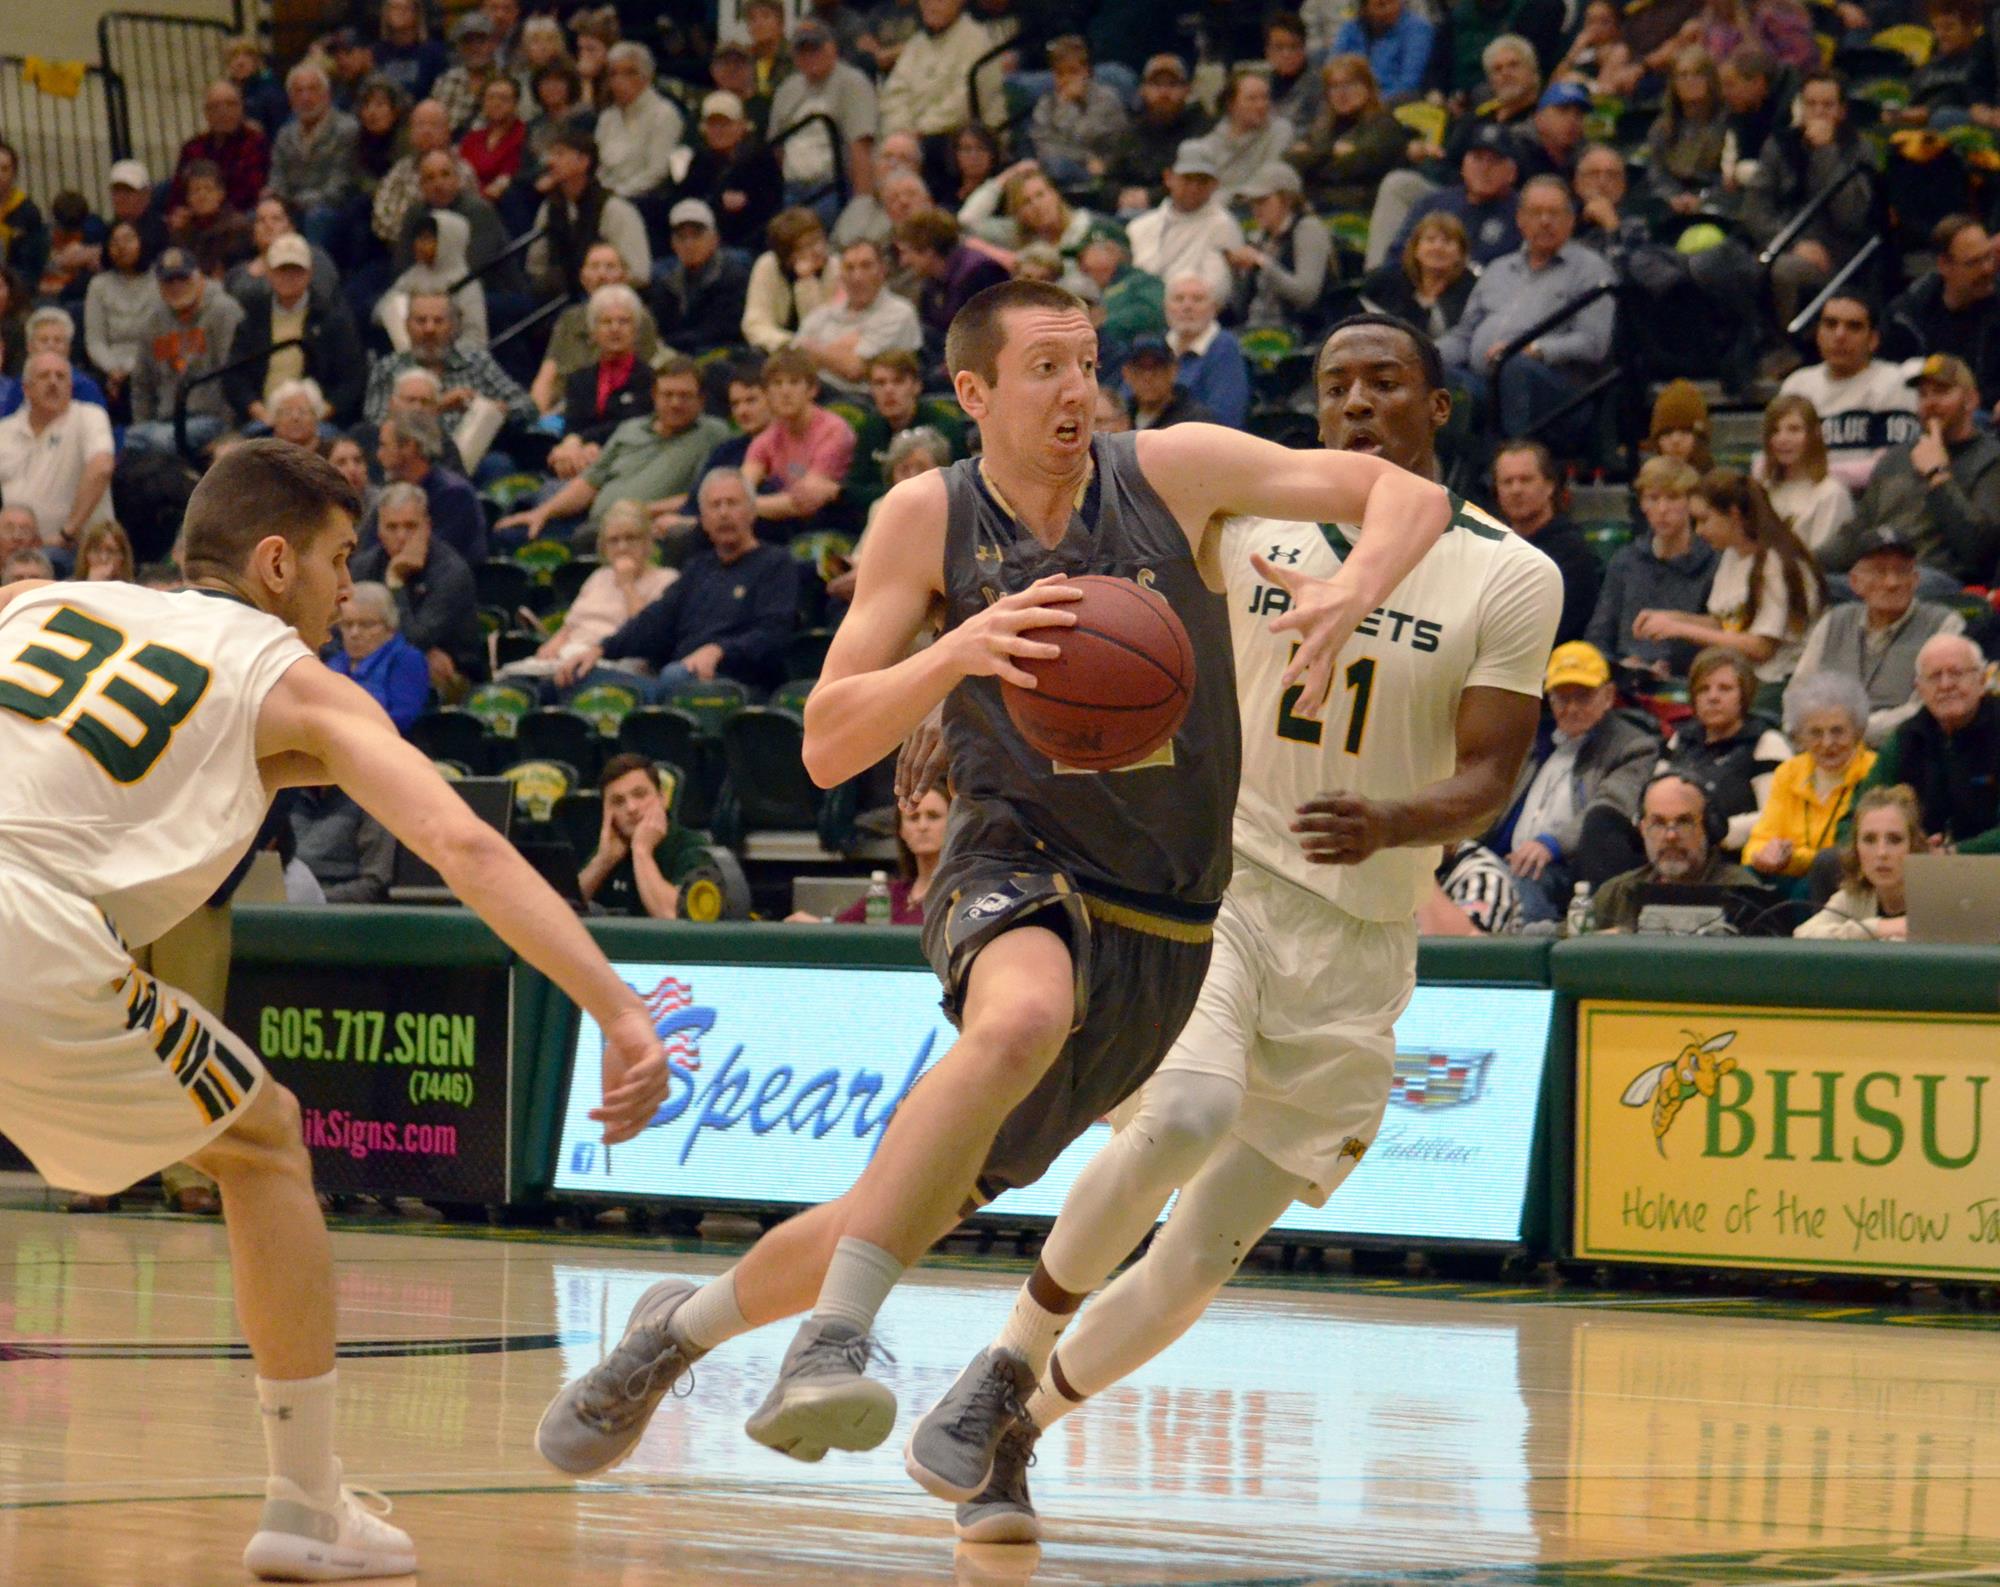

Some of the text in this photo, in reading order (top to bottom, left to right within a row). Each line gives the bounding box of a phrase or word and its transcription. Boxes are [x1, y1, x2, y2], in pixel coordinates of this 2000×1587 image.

[1248, 585, 1443, 653] JAETS
[0, 603, 214, 788] 33
[1275, 640, 1378, 758] 21
[260, 1006, 475, 1067] 605.717.SIGN
[409, 1070, 474, 1109] (7446)
[1700, 1065, 1990, 1170] BHSU
[1622, 1186, 1708, 1234] Home
[1725, 1188, 1760, 1234] of
[1774, 1189, 1826, 1238] the
[1843, 1196, 1950, 1251] Yellow
